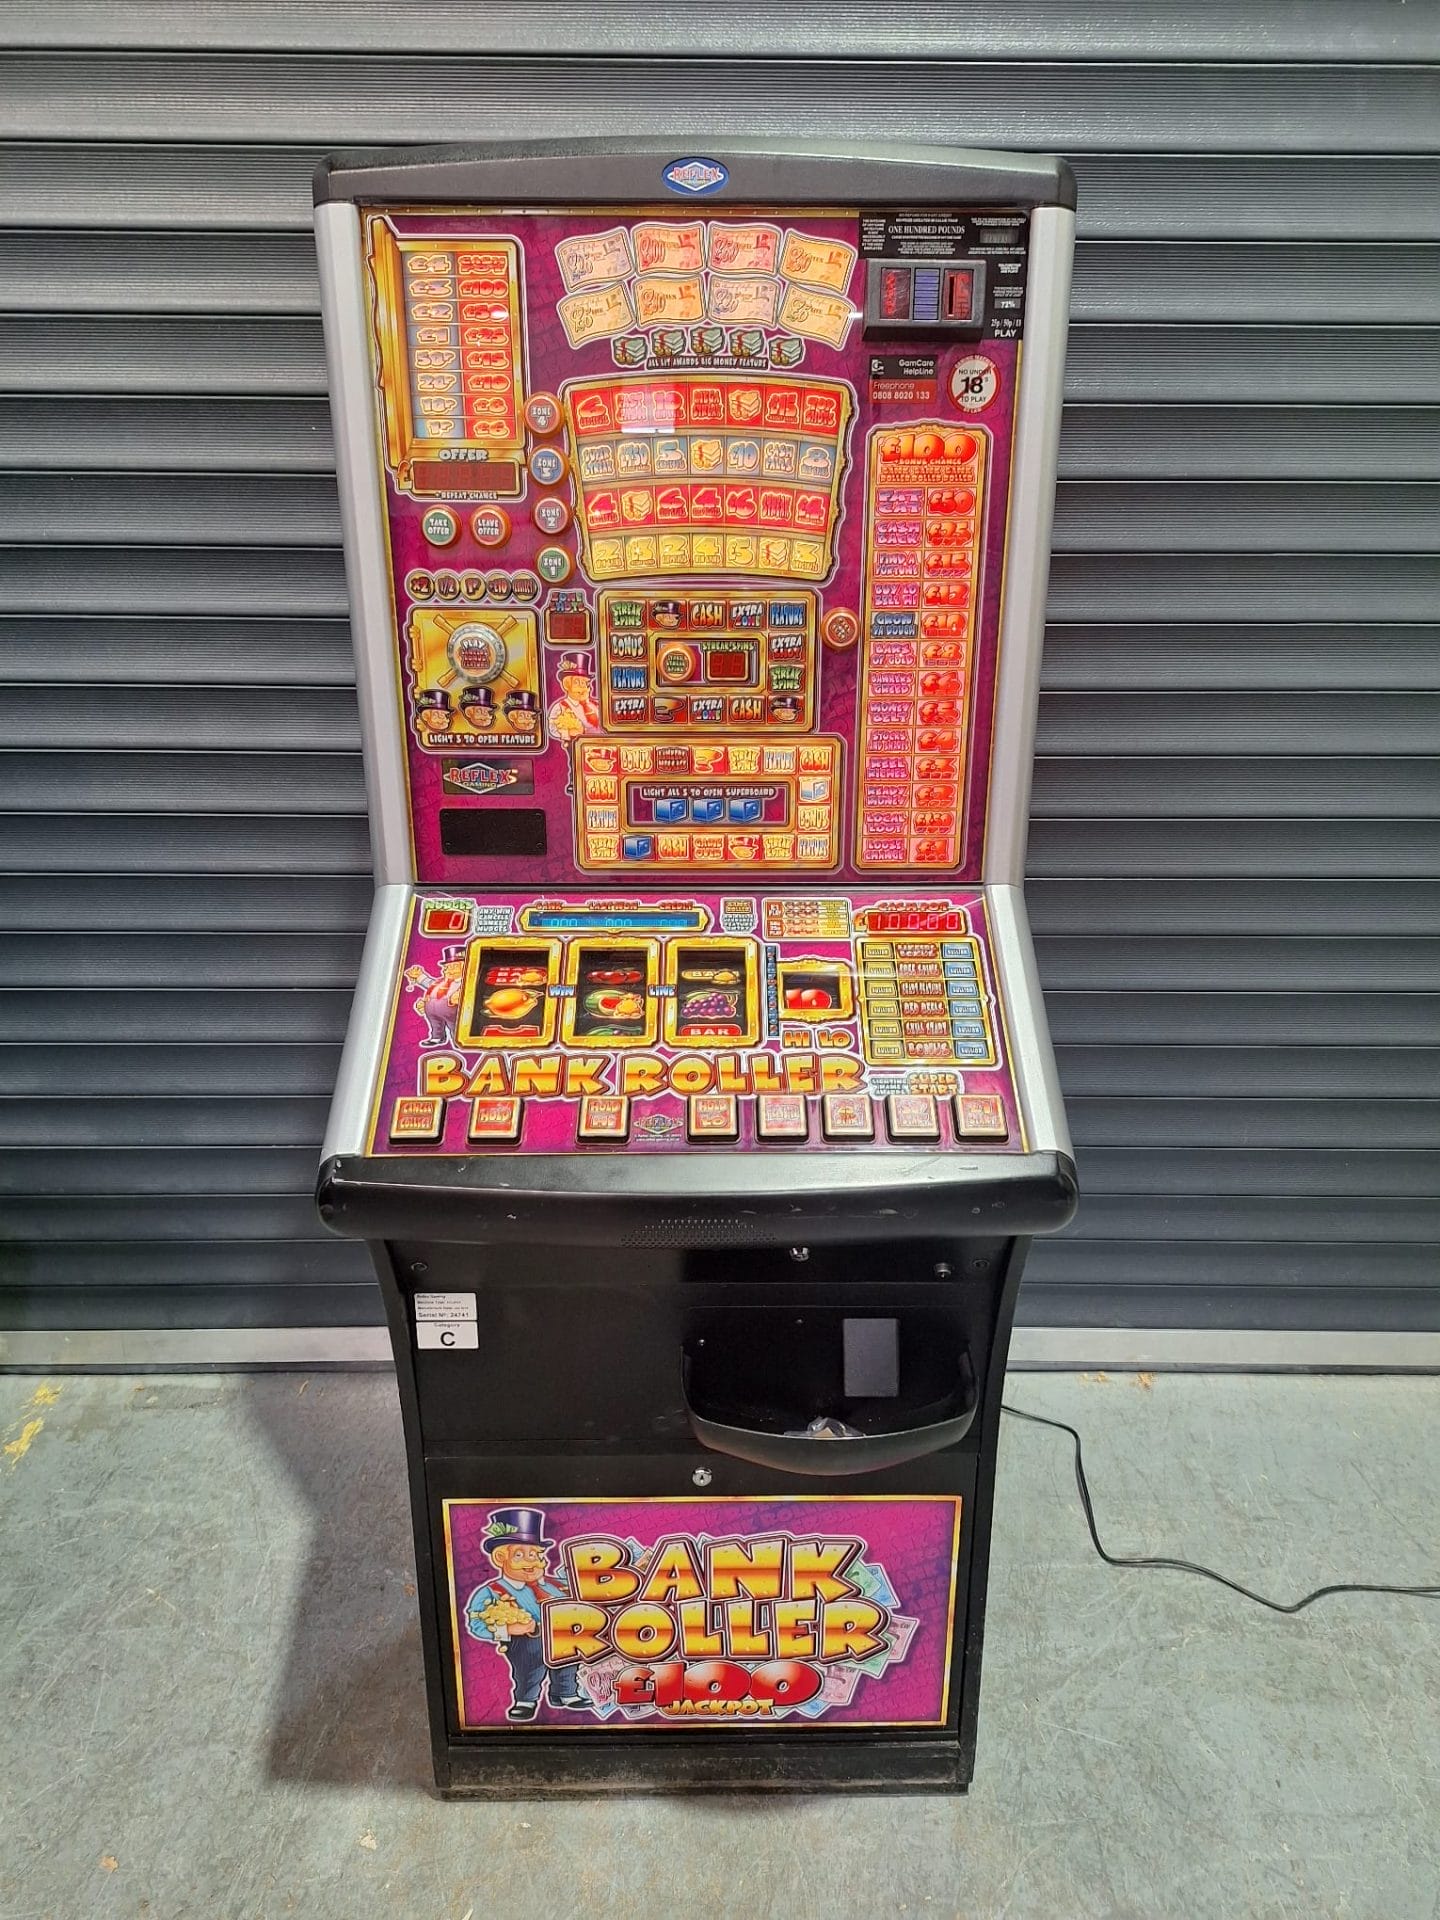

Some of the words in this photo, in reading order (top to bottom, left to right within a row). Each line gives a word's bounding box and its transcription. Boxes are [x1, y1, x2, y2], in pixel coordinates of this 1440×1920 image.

[673, 166, 720, 180] REFLEX
[904, 226, 937, 234] HUNDRED
[938, 226, 965, 234] POUNDS
[460, 280, 508, 297] £100
[899, 359, 934, 367] GamCare
[873, 382, 915, 391] Freephone
[872, 391, 892, 399] 0808
[894, 391, 914, 399] 8020
[916, 391, 930, 399] 133
[532, 407, 551, 415] ZONE
[881, 434, 978, 463] £100
[439, 449, 488, 460] OFFER
[538, 458, 556, 467] ZONE
[441, 492, 467, 500] REPEAT
[469, 492, 497, 500] CHANCE
[930, 490, 974, 513] £50
[541, 508, 560, 517] ZONE
[879, 501, 919, 513] CAT
[429, 518, 448, 527] TAKE
[478, 519, 499, 528] LEAVE
[878, 521, 920, 532] CASH
[428, 527, 450, 535] OFFER
[478, 527, 500, 535] OFFER
[543, 557, 562, 566] ZONE
[928, 553, 969, 571] £15
[926, 584, 968, 605] £12
[611, 602, 644, 615] STREAK
[731, 603, 764, 617] EXTRA
[613, 613, 643, 626] SPINS
[692, 602, 723, 627] CASH
[771, 603, 804, 627] FEATURE
[876, 613, 912, 625] GROW
[924, 612, 964, 632] £10
[463, 639, 486, 649] PLAY
[611, 635, 645, 659] BONUS
[889, 655, 914, 665] GOLD
[870, 702, 911, 712] MONEY
[429, 734, 453, 743] LIGHT
[464, 734, 475, 743] TO
[478, 734, 499, 743] OPEN
[501, 734, 535, 744] FEATURE
[643, 787, 665, 796] LIGHT
[667, 787, 680, 796] ALL
[726, 787, 775, 796] SUPERBOARD
[869, 823, 903, 832] LOOT
[425, 900, 473, 909] NUDGES
[536, 902, 564, 910] BANK
[550, 986, 575, 997] WIN
[651, 986, 676, 997] LINE
[690, 1027, 729, 1036] BAR
[784, 1031, 811, 1047] HI
[818, 1030, 852, 1047] LO
[907, 1042, 951, 1057] BONUS
[421, 1054, 614, 1098] BANK
[620, 1052, 867, 1098] ROLLER
[910, 1072, 957, 1084] SUPER
[910, 1084, 959, 1095] START
[589, 1101, 622, 1113] HOLD
[700, 1100, 729, 1112] HOLD
[480, 1109, 512, 1122] HOLD
[399, 1117, 432, 1128] COLLECT
[440, 1331, 456, 1347] C
[563, 1535, 864, 1604] BANK
[543, 1599, 894, 1665] ROLLER
[612, 1660, 824, 1708] £100
[663, 1698, 776, 1717] JACKPOT
